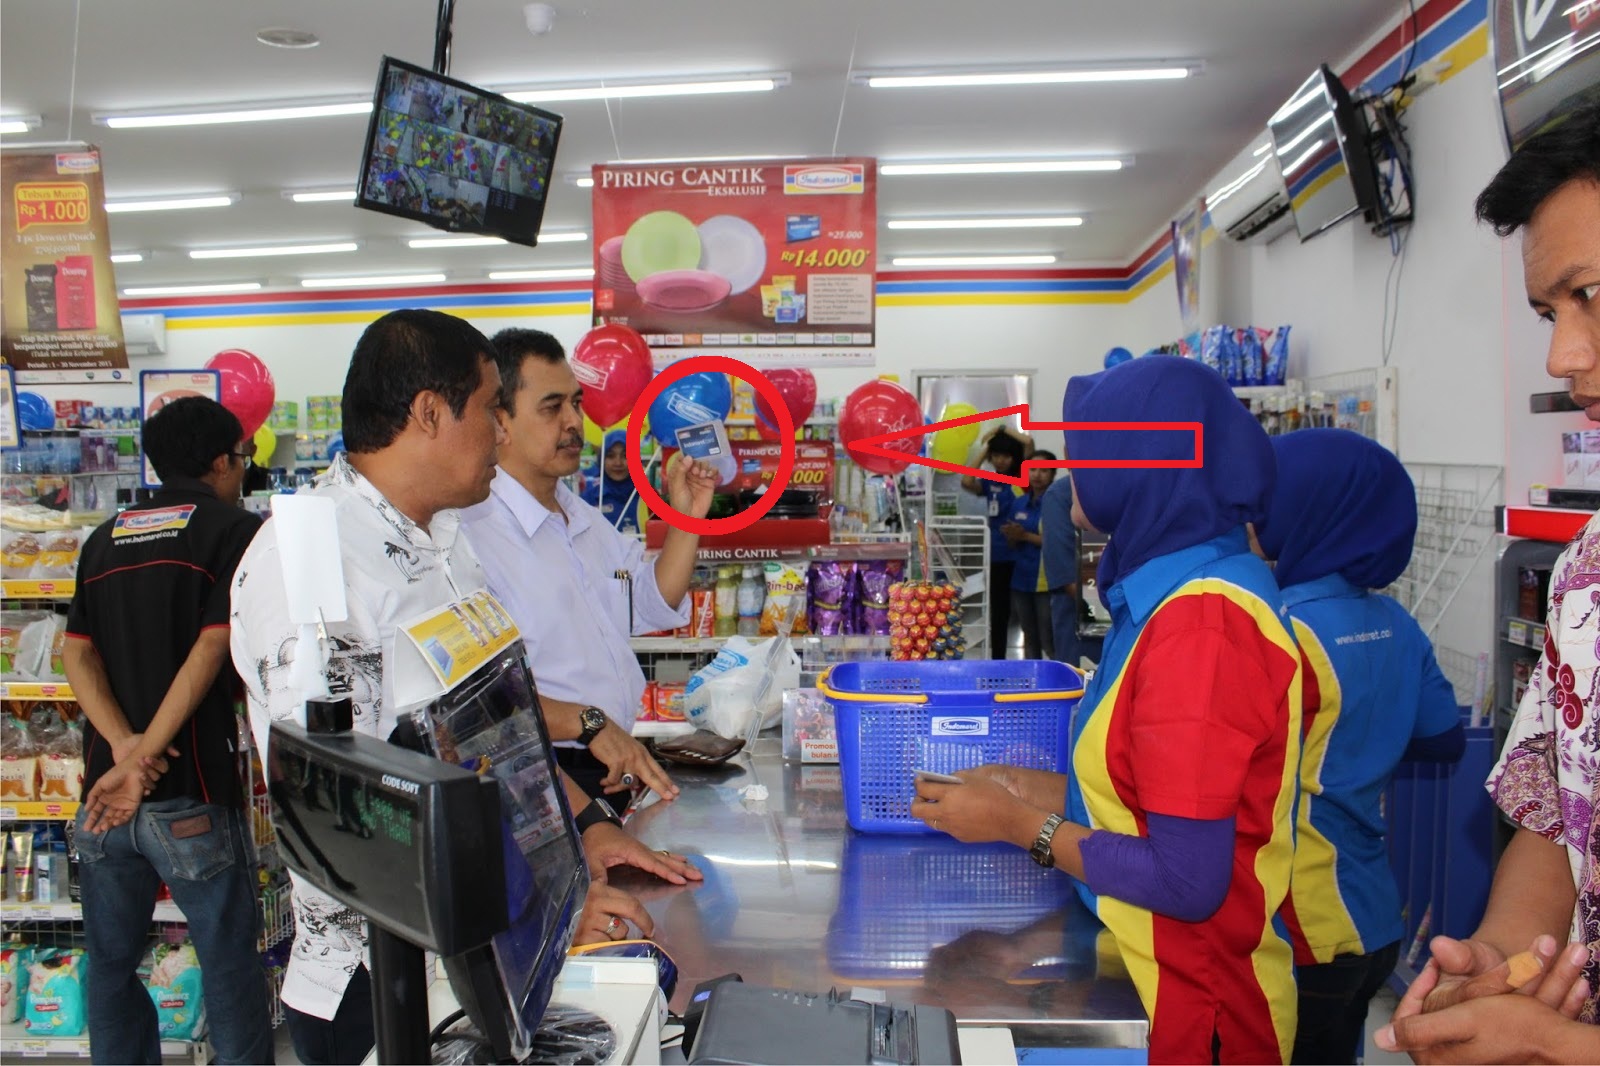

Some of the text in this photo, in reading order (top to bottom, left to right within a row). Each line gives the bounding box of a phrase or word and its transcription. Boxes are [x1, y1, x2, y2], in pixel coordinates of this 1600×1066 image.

[602, 167, 765, 188] PIRING CANTIK
[800, 174, 848, 184] Indomaret
[708, 185, 767, 196] EKSKLUSIF
[738, 448, 767, 456] PIRING
[697, 548, 778, 559] IRING CANTIK
[805, 742, 836, 750] Promosi
[382, 774, 420, 795] CODE SOFT
